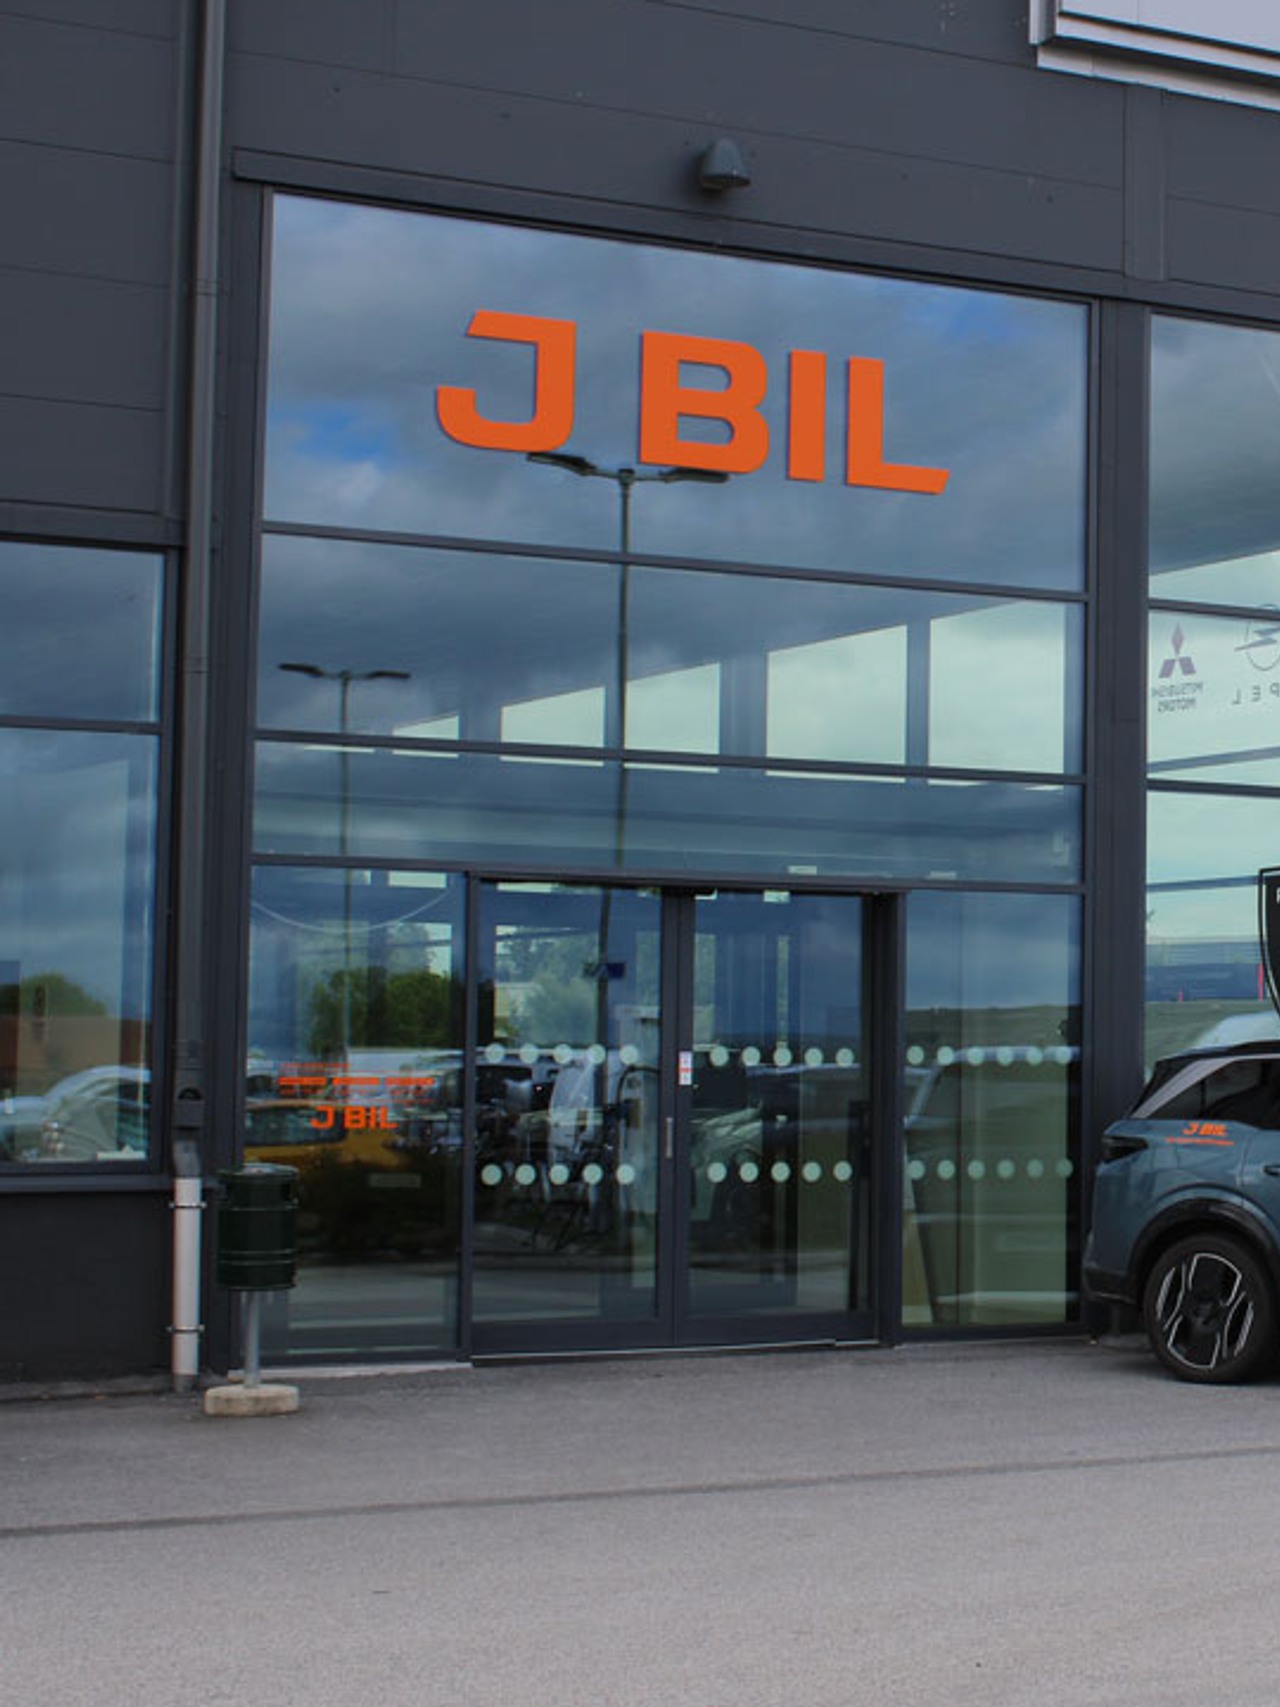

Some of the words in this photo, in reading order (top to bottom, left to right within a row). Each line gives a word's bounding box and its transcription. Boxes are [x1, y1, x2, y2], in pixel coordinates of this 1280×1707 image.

[435, 309, 577, 452] J
[638, 330, 951, 495] BIL
[311, 1105, 335, 1129] J
[343, 1106, 400, 1129] BIL
